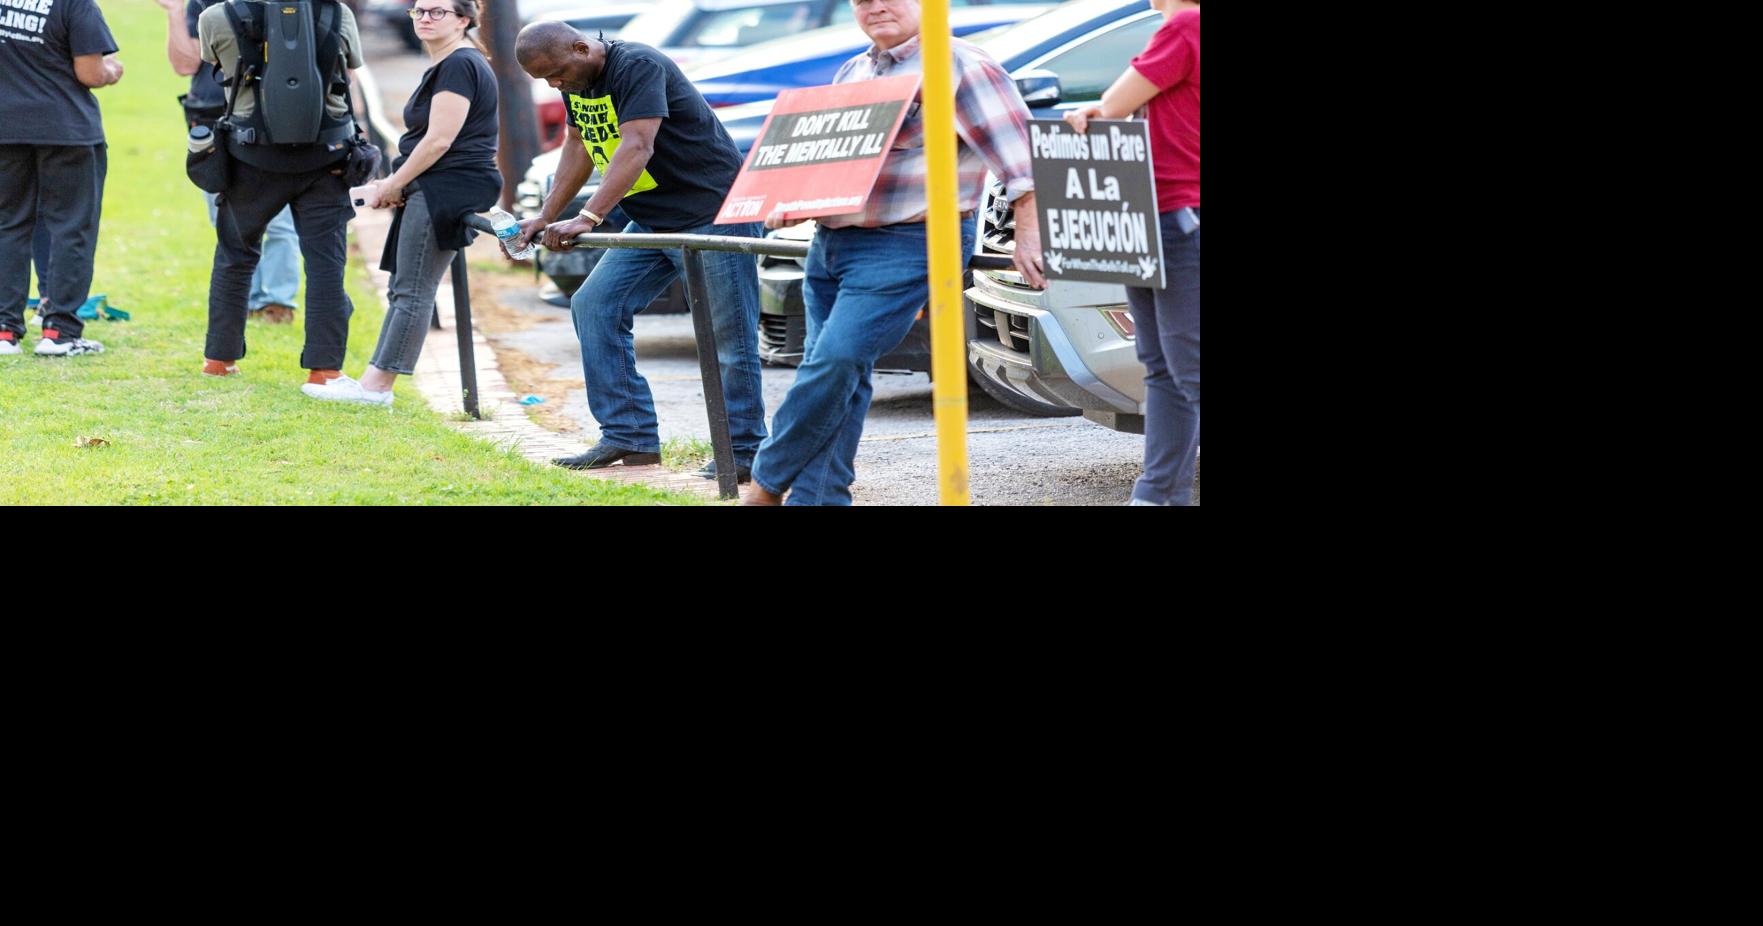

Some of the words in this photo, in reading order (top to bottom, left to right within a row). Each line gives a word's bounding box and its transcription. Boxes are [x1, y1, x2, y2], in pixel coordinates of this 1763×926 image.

[792, 112, 841, 137] DON'T
[836, 109, 872, 132] KILL
[755, 144, 788, 166] THE
[784, 134, 864, 163] MENTALLY
[859, 133, 885, 155] ILL
[1030, 124, 1090, 160] Pedimos
[1090, 134, 1110, 160] un
[1110, 125, 1146, 162] Pare
[1066, 167, 1085, 200] A
[1088, 168, 1121, 201] La
[1047, 201, 1149, 254] EJECUCIÓN
